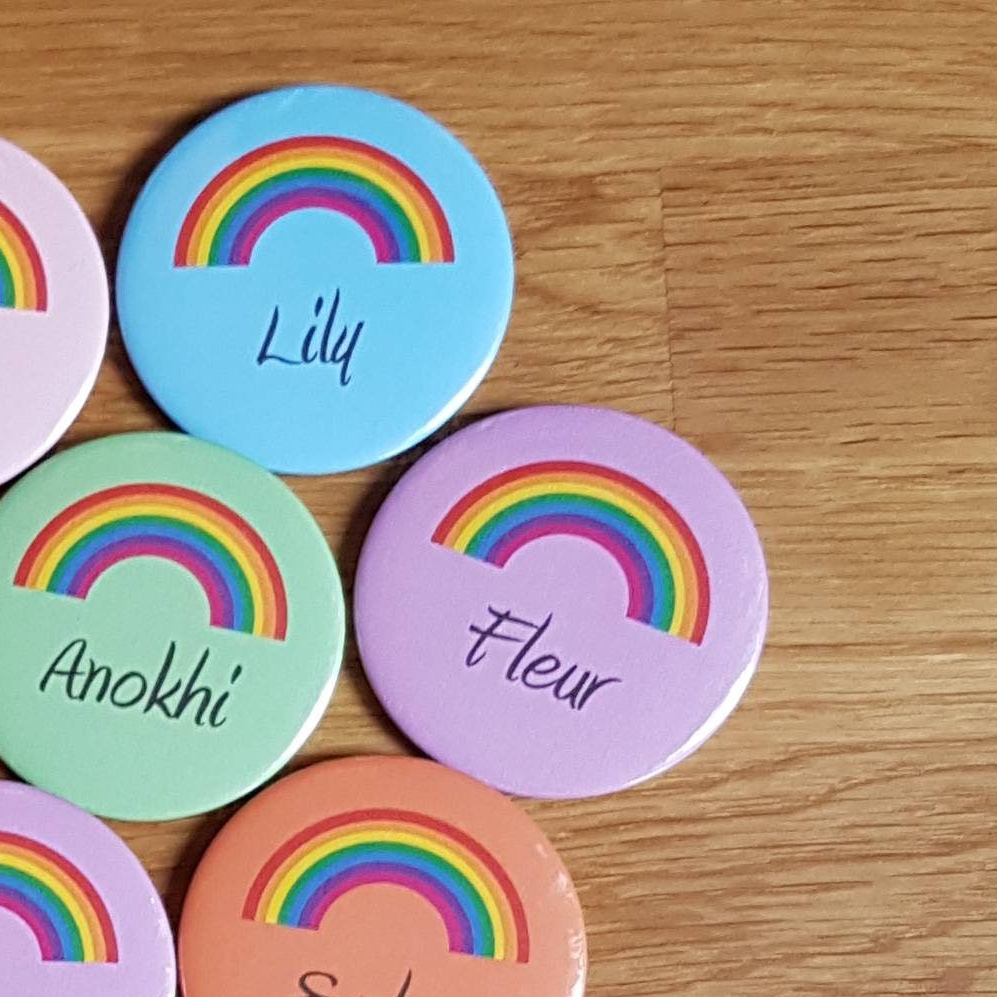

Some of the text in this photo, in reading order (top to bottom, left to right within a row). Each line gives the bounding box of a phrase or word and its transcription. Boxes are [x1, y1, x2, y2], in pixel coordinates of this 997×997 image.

[256, 288, 365, 386] Lily
[39, 639, 243, 728] Anokhi
[465, 606, 620, 711] Fleur
